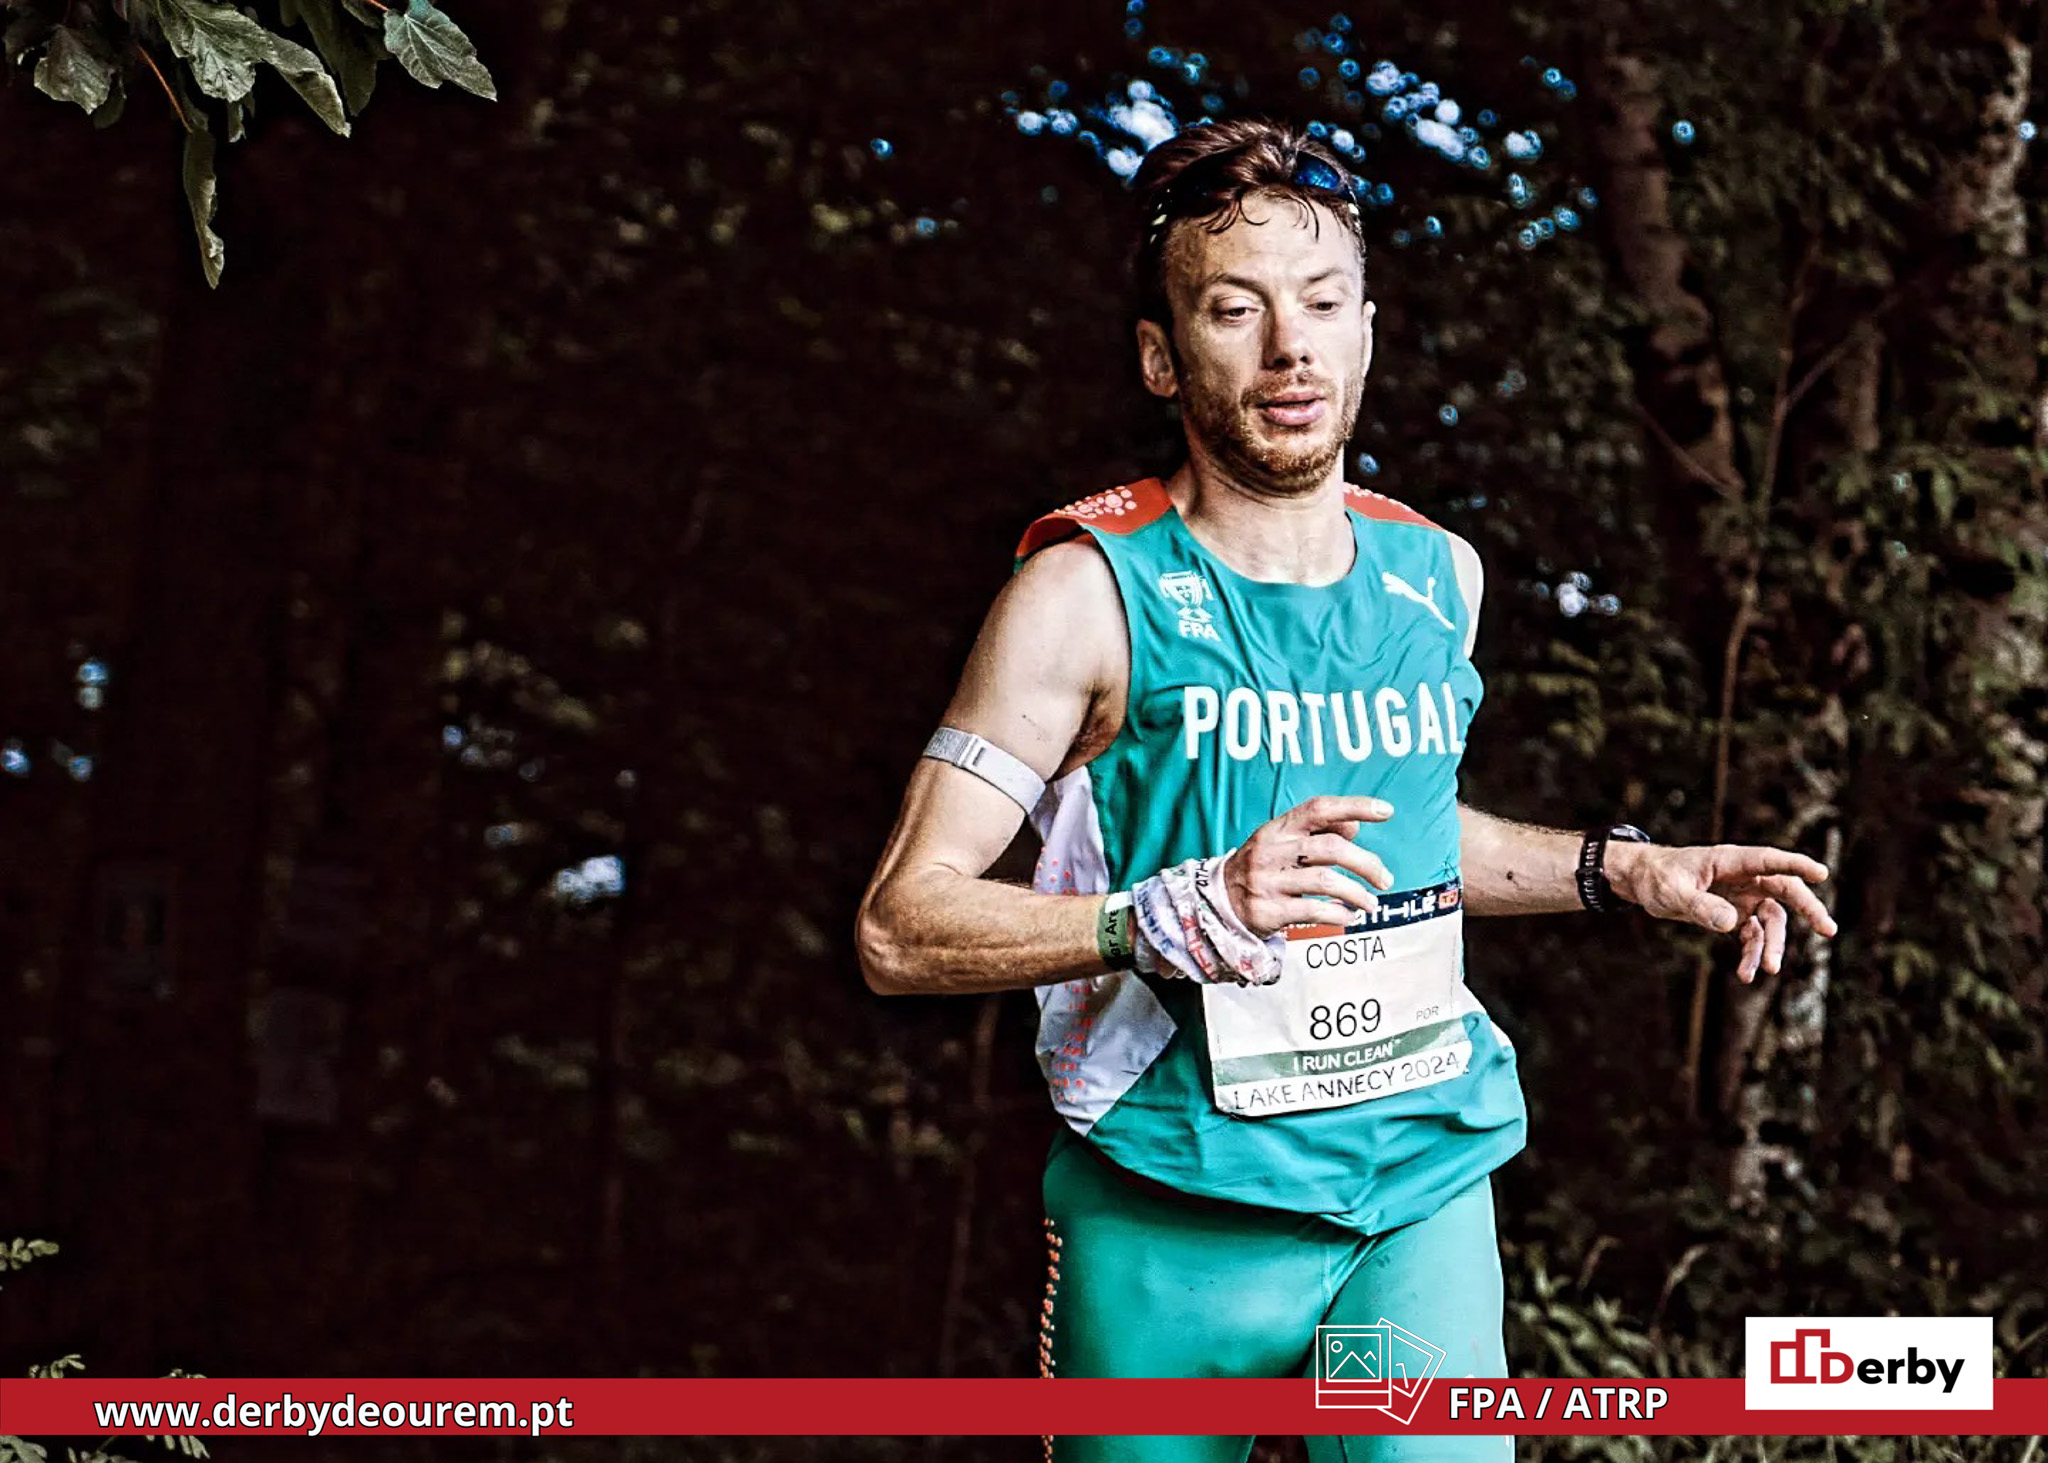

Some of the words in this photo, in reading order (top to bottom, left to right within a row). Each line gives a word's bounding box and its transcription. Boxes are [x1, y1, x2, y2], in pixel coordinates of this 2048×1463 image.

[1183, 681, 1465, 765] PORTUGAL
[1306, 935, 1386, 969] COSTA
[1309, 998, 1382, 1041] 869
[1416, 1005, 1439, 1020] POR
[1234, 1084, 1297, 1110] LAKE
[1302, 1066, 1395, 1100] ANNECY
[1401, 1051, 1460, 1083] 2024
[1293, 1056, 1299, 1071] I
[1302, 1053, 1341, 1072] RUN
